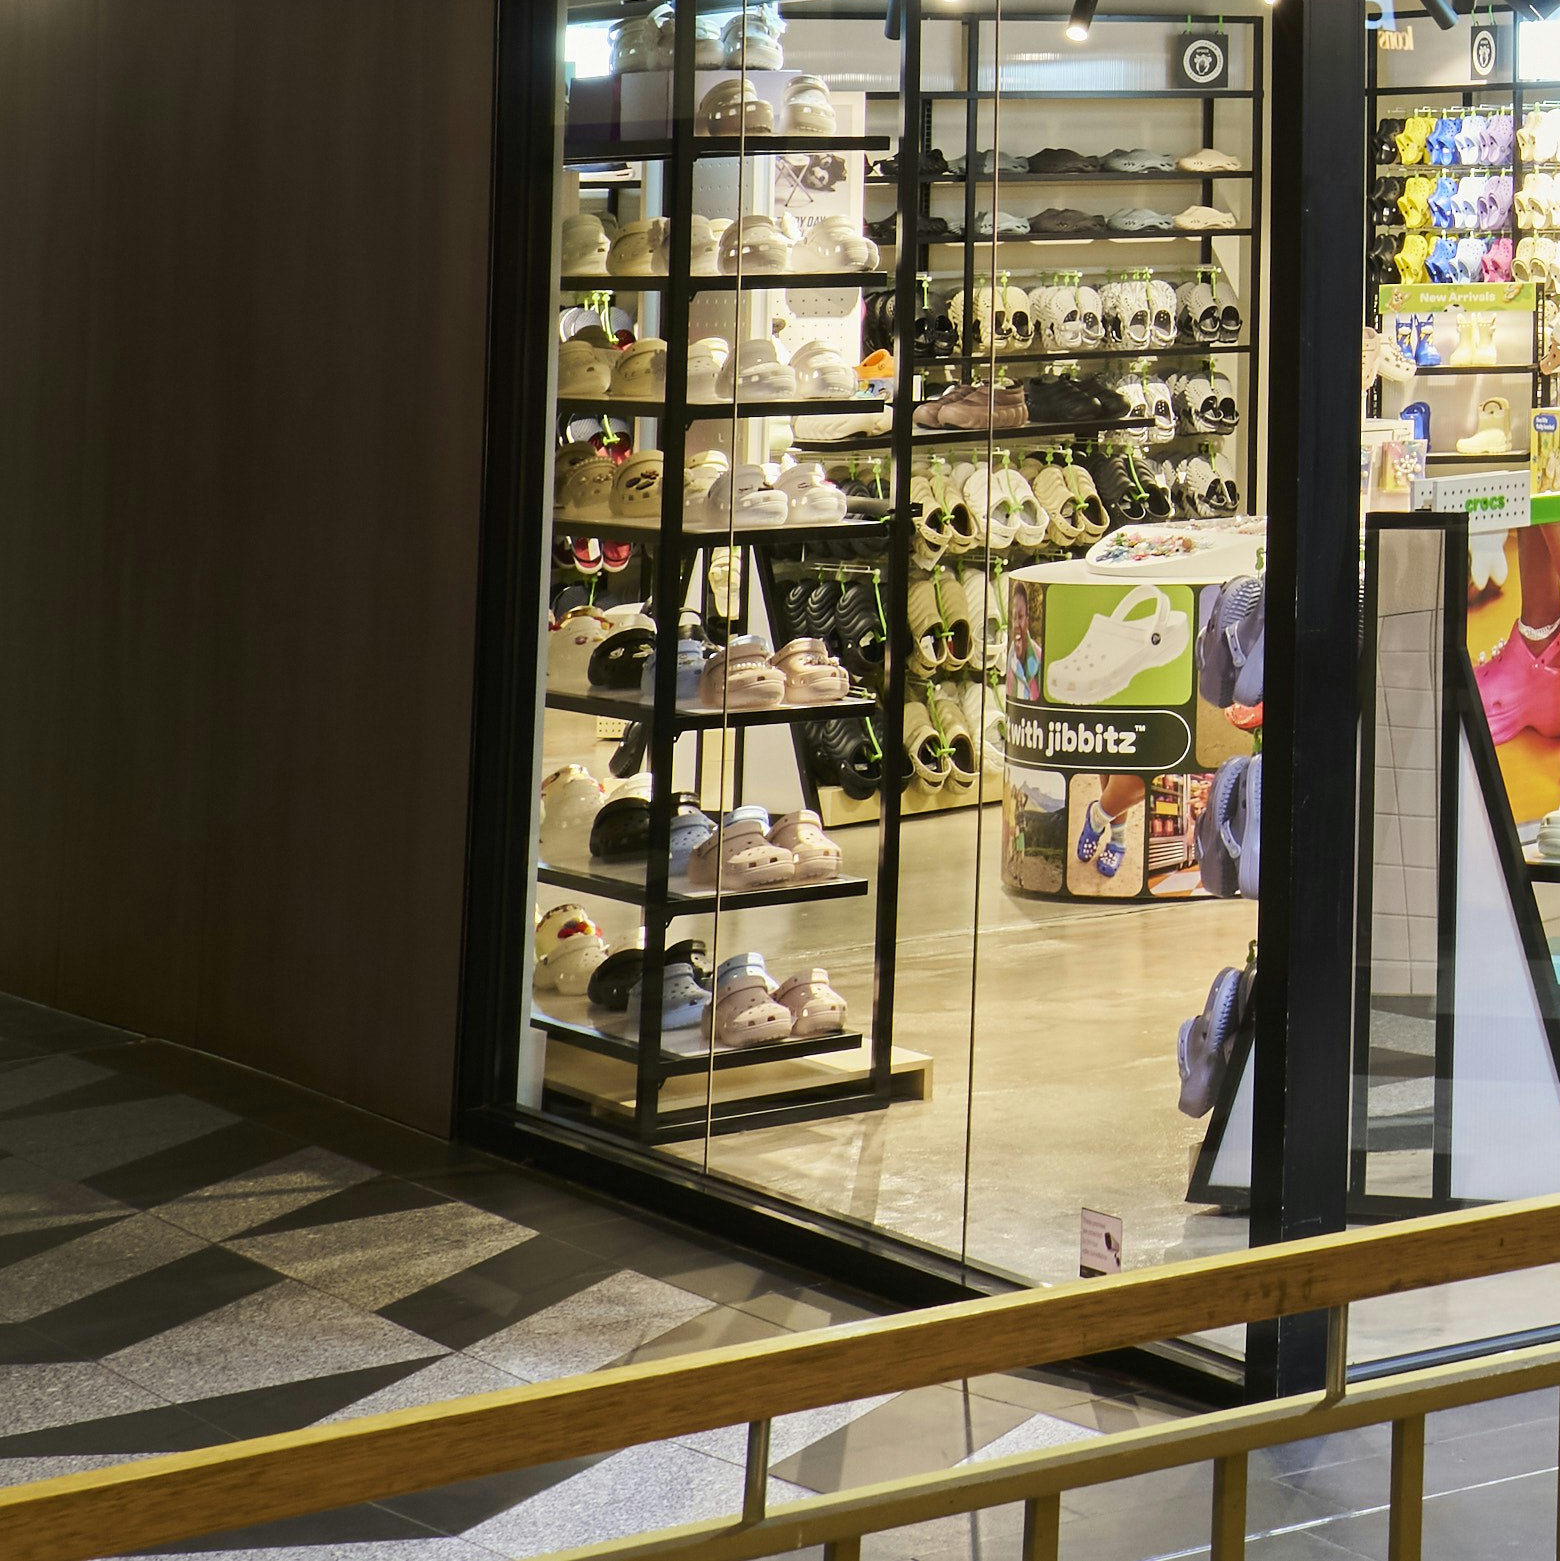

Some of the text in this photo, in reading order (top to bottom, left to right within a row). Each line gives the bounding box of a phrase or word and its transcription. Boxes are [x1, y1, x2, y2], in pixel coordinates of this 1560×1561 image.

[1420, 292, 1496, 303] New Arrivals
[1465, 494, 1506, 512] crocs
[1011, 718, 1043, 750] with
